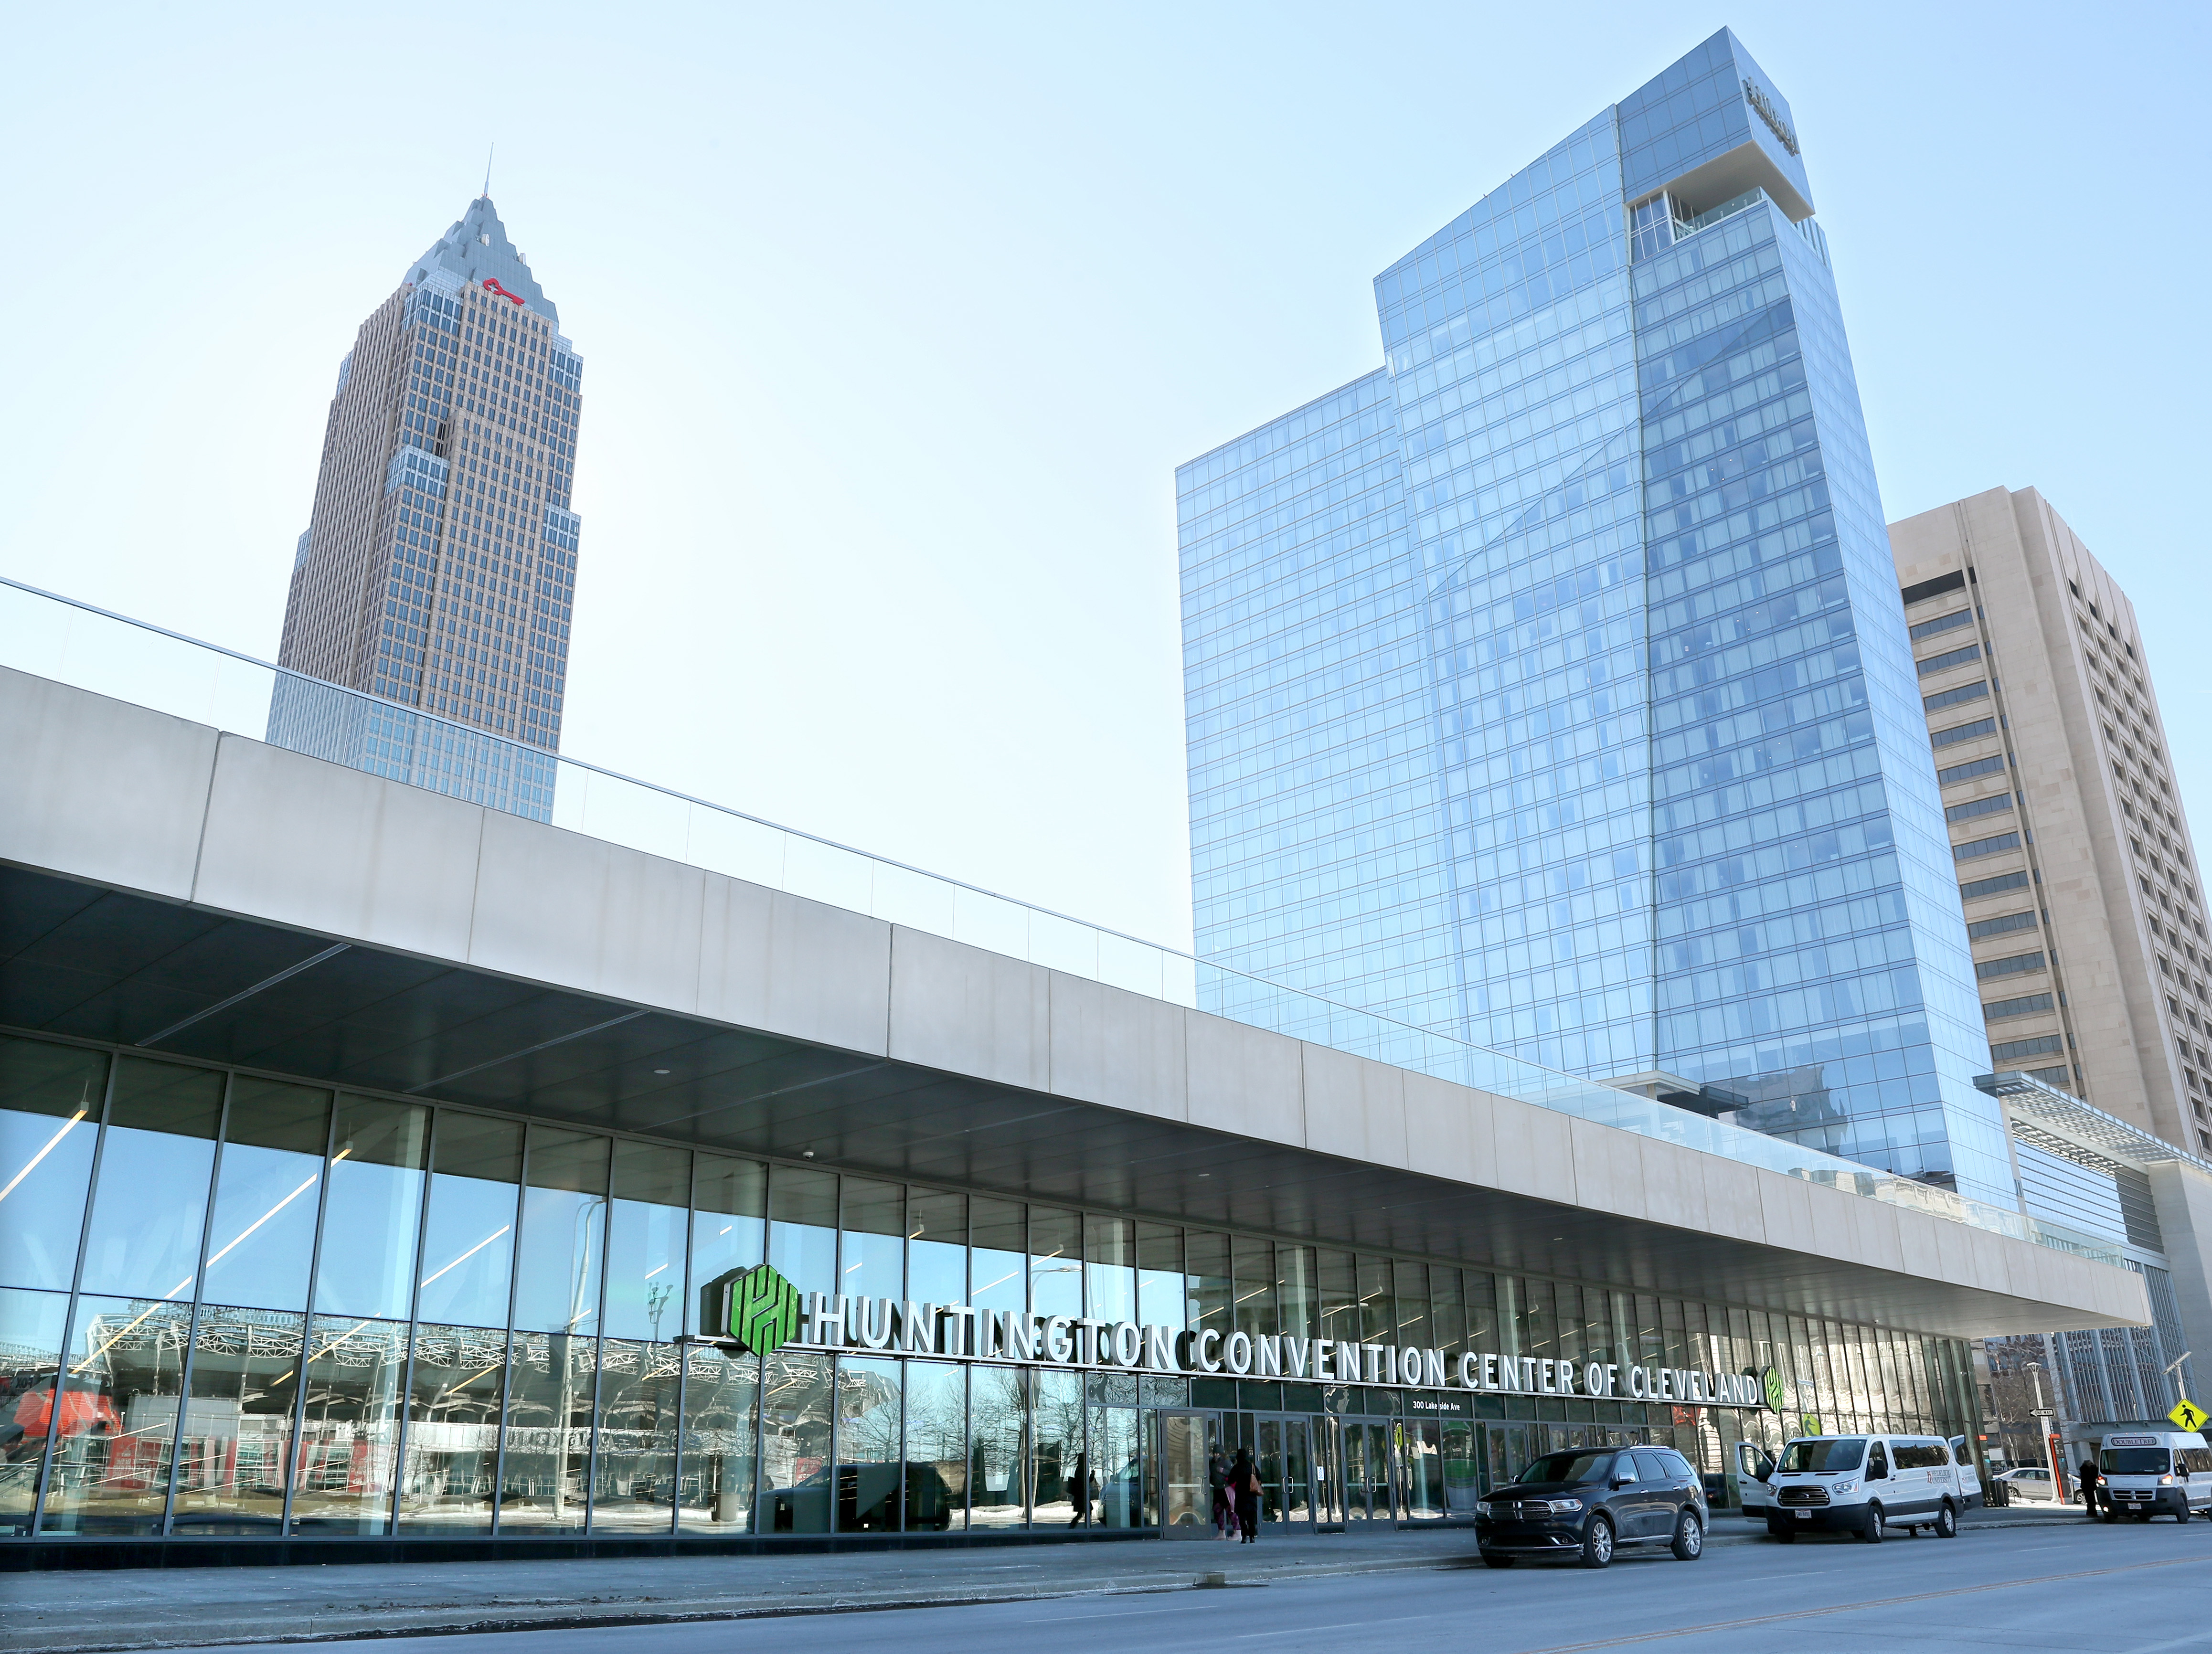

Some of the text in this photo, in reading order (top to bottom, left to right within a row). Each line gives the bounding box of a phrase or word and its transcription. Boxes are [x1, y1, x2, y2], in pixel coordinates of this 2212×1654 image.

[809, 1291, 1758, 1405] HUNTINGTON CONVENTION CENTER OF CLEVELAND
[1413, 1400, 1425, 1409] 300
[1450, 1402, 1460, 1411] Ave
